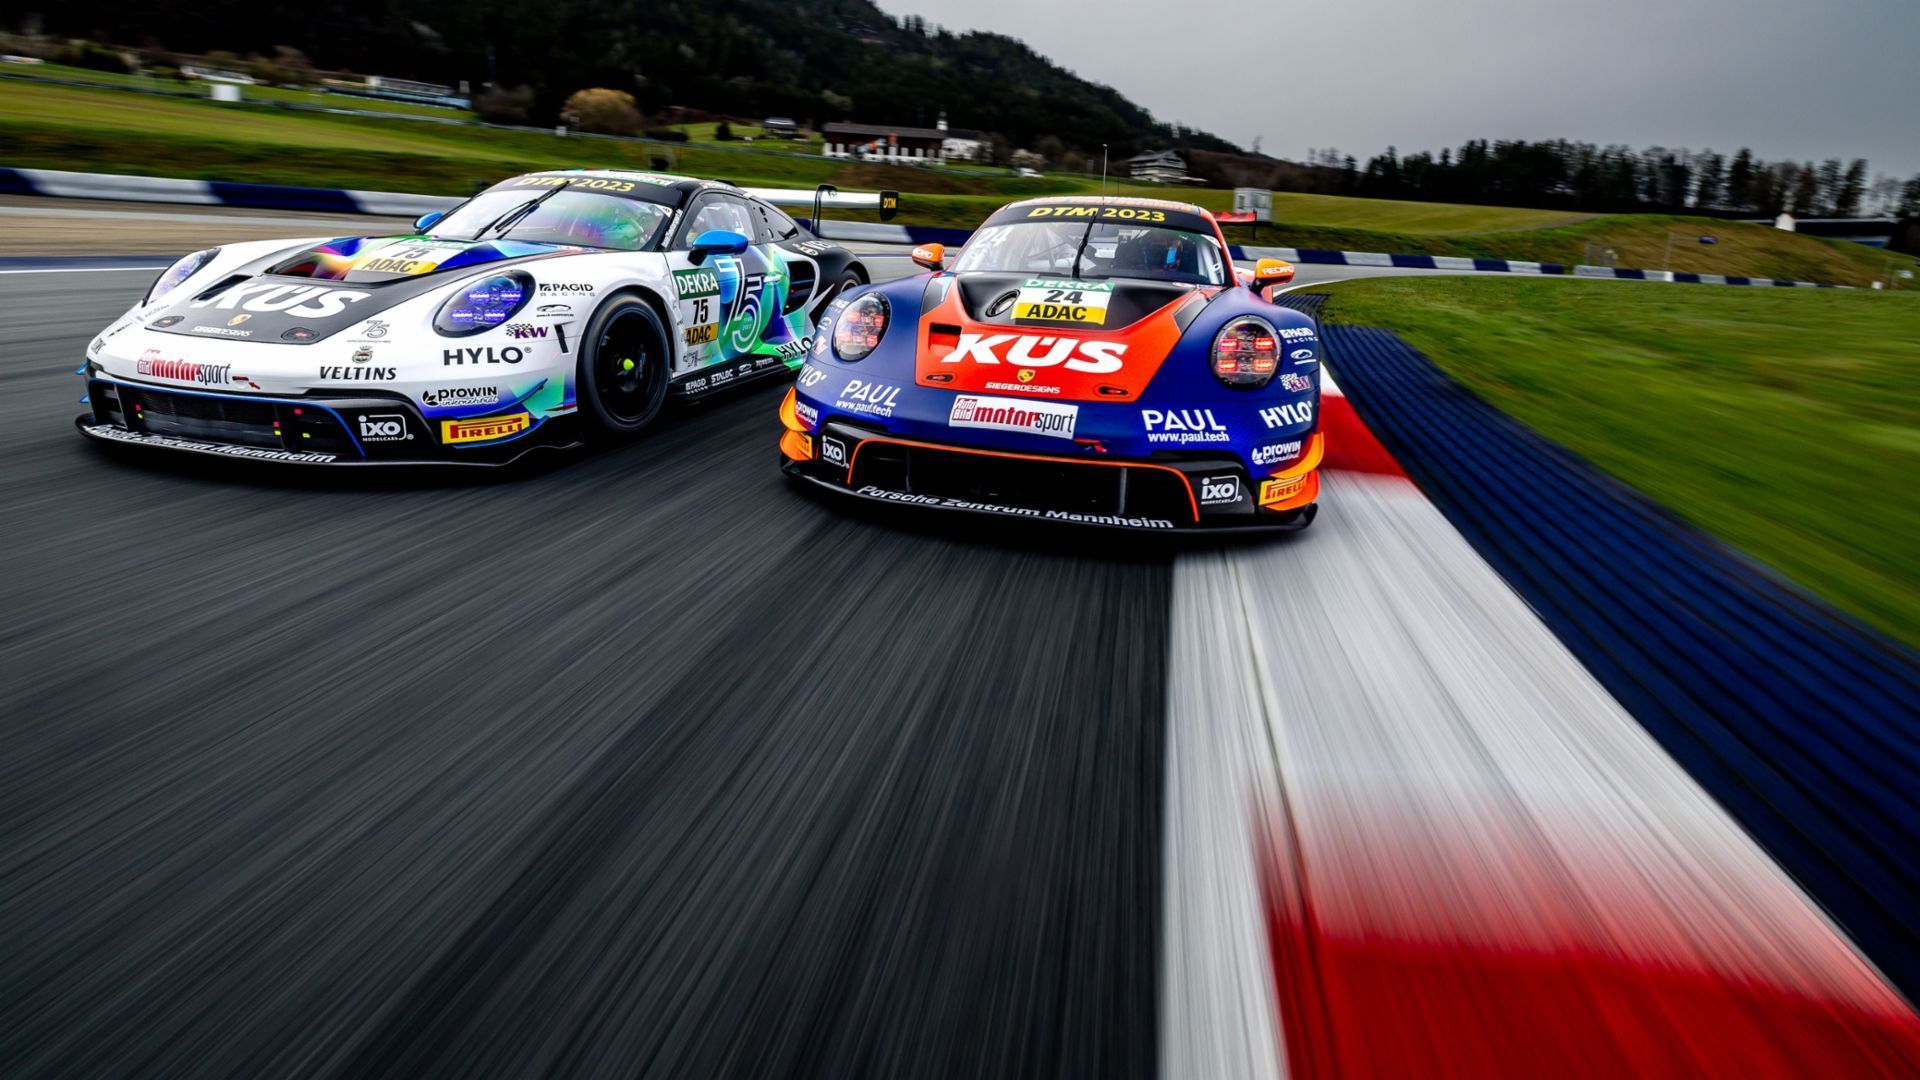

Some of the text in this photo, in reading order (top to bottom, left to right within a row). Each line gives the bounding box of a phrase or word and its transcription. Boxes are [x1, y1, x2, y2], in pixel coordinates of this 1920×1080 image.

[574, 178, 636, 192] 2023
[883, 197, 897, 209] DTM
[1027, 207, 1166, 222] DTM 2023
[392, 246, 436, 259] 75
[361, 258, 418, 273] ADAC
[552, 283, 594, 292] PAGID
[676, 272, 719, 295] DEKRA
[1024, 279, 1110, 291] DEKRA
[714, 258, 763, 353] 75
[1044, 289, 1084, 304] 24
[693, 299, 709, 325] 75
[1027, 304, 1087, 320] ADAC
[514, 326, 549, 339] KW
[685, 325, 711, 346] ADAC
[775, 336, 814, 358] HYLO
[940, 333, 1129, 374] KÜS
[320, 366, 397, 380] VELTINS
[798, 363, 822, 387] YLO
[840, 380, 901, 407] PAUL
[985, 382, 1061, 394] SIEGERDESIGNS
[835, 399, 892, 418] www.paul.tech
[450, 417, 523, 440] PIRELLI
[973, 406, 1074, 433] motorsport
[1141, 409, 1227, 431] PAUL
[1148, 430, 1230, 445] www.paul.tech
[212, 444, 337, 464] Mannheim
[857, 485, 1174, 529] Porsche Zentrum Mannheim
